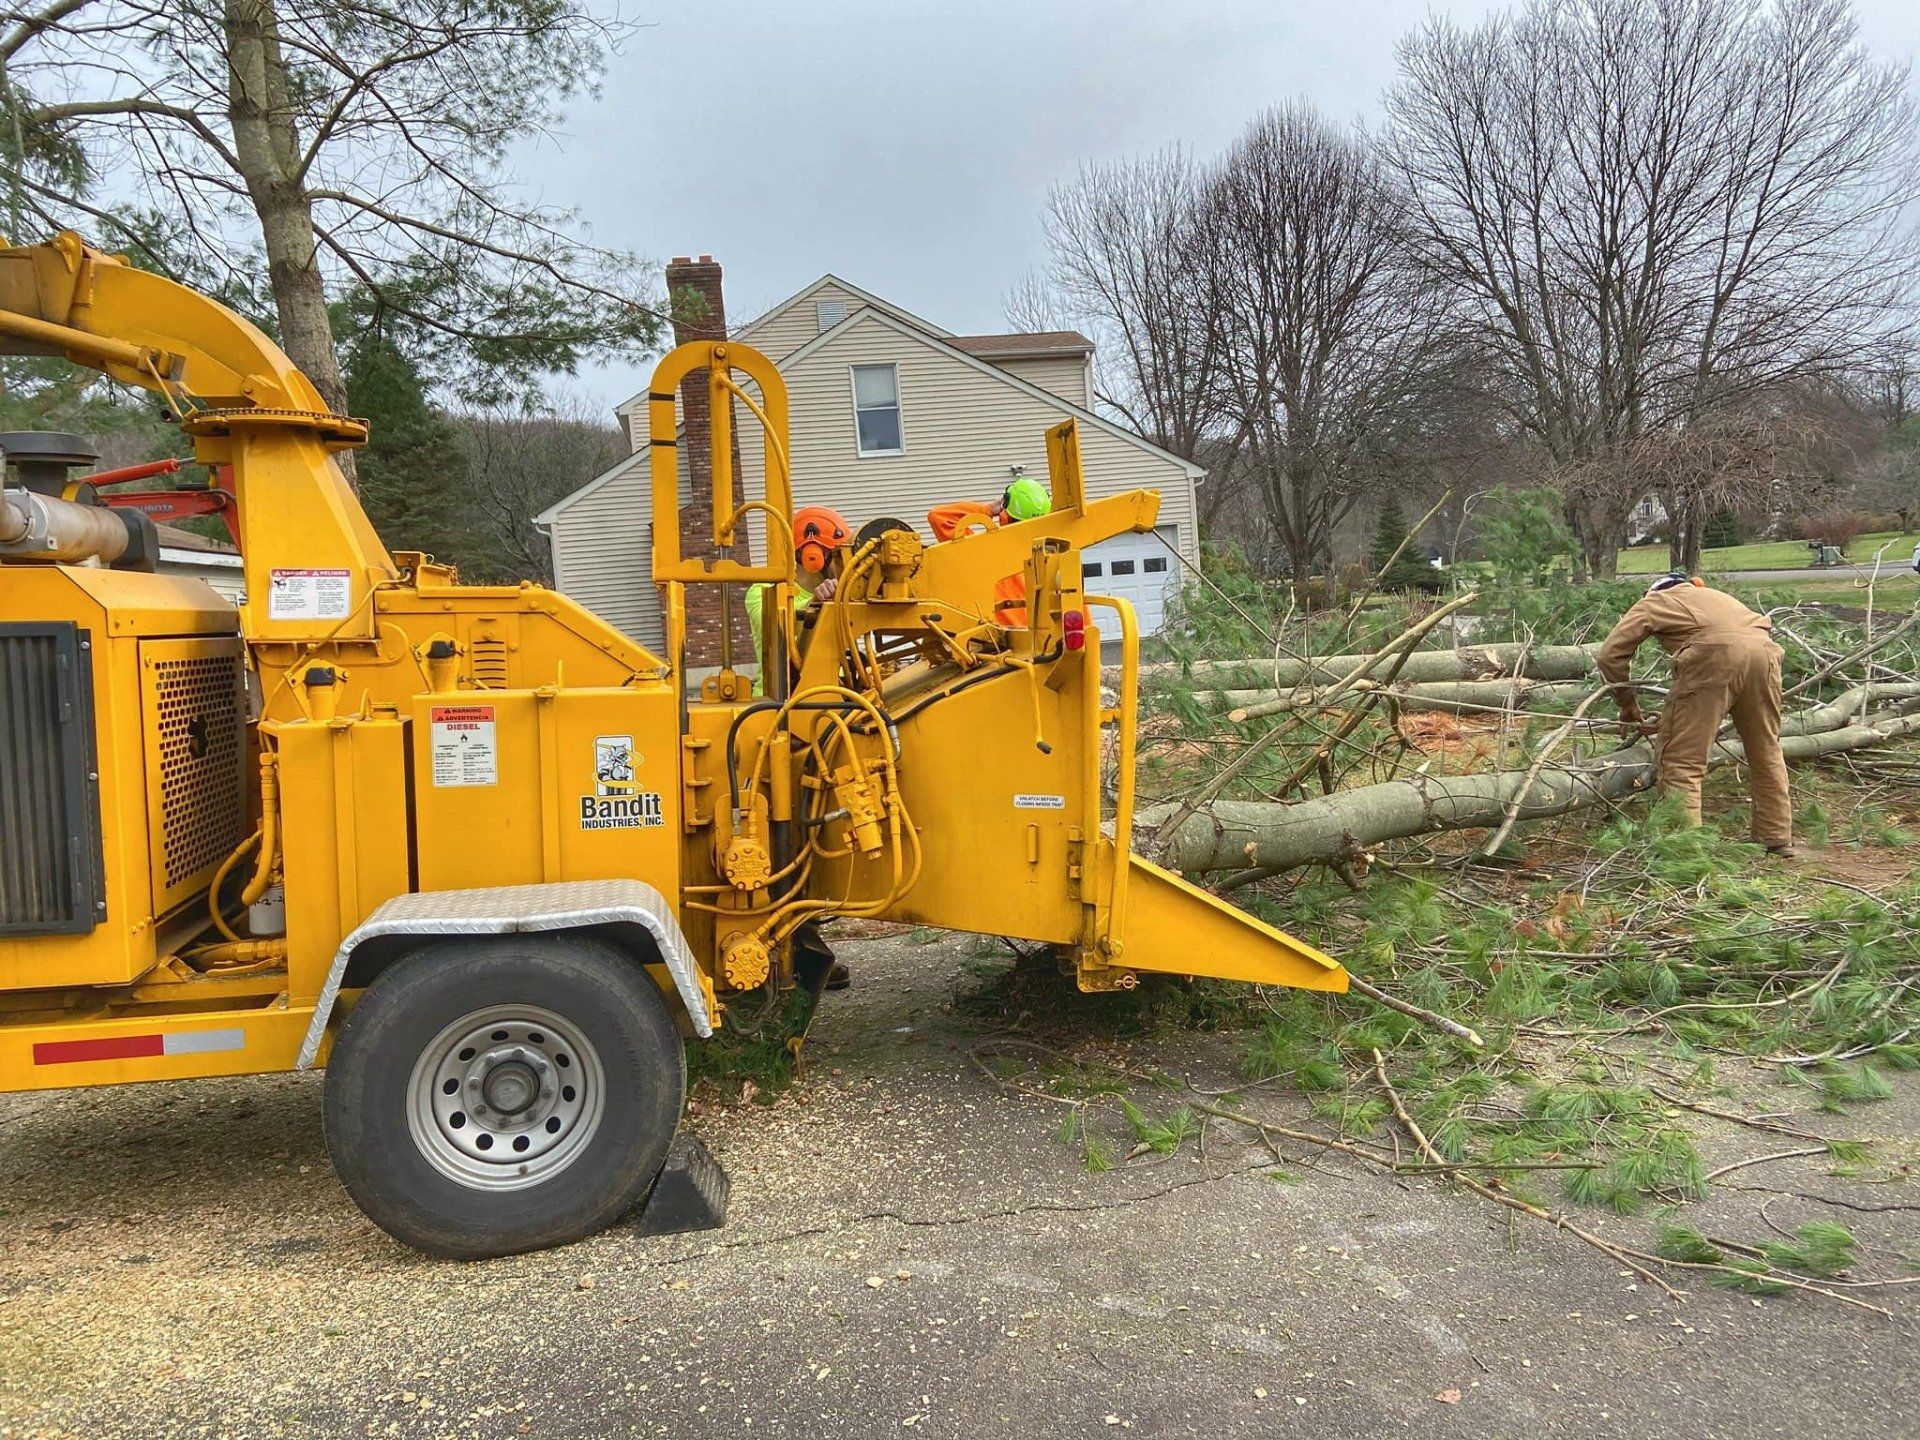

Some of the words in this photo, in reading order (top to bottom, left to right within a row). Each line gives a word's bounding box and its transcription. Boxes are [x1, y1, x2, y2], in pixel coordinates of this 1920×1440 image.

[446, 723, 481, 731] DIESEL
[581, 793, 661, 819] Bandit
[581, 818, 642, 830] INDUSTRIES,
[645, 816, 664, 826] INC.
